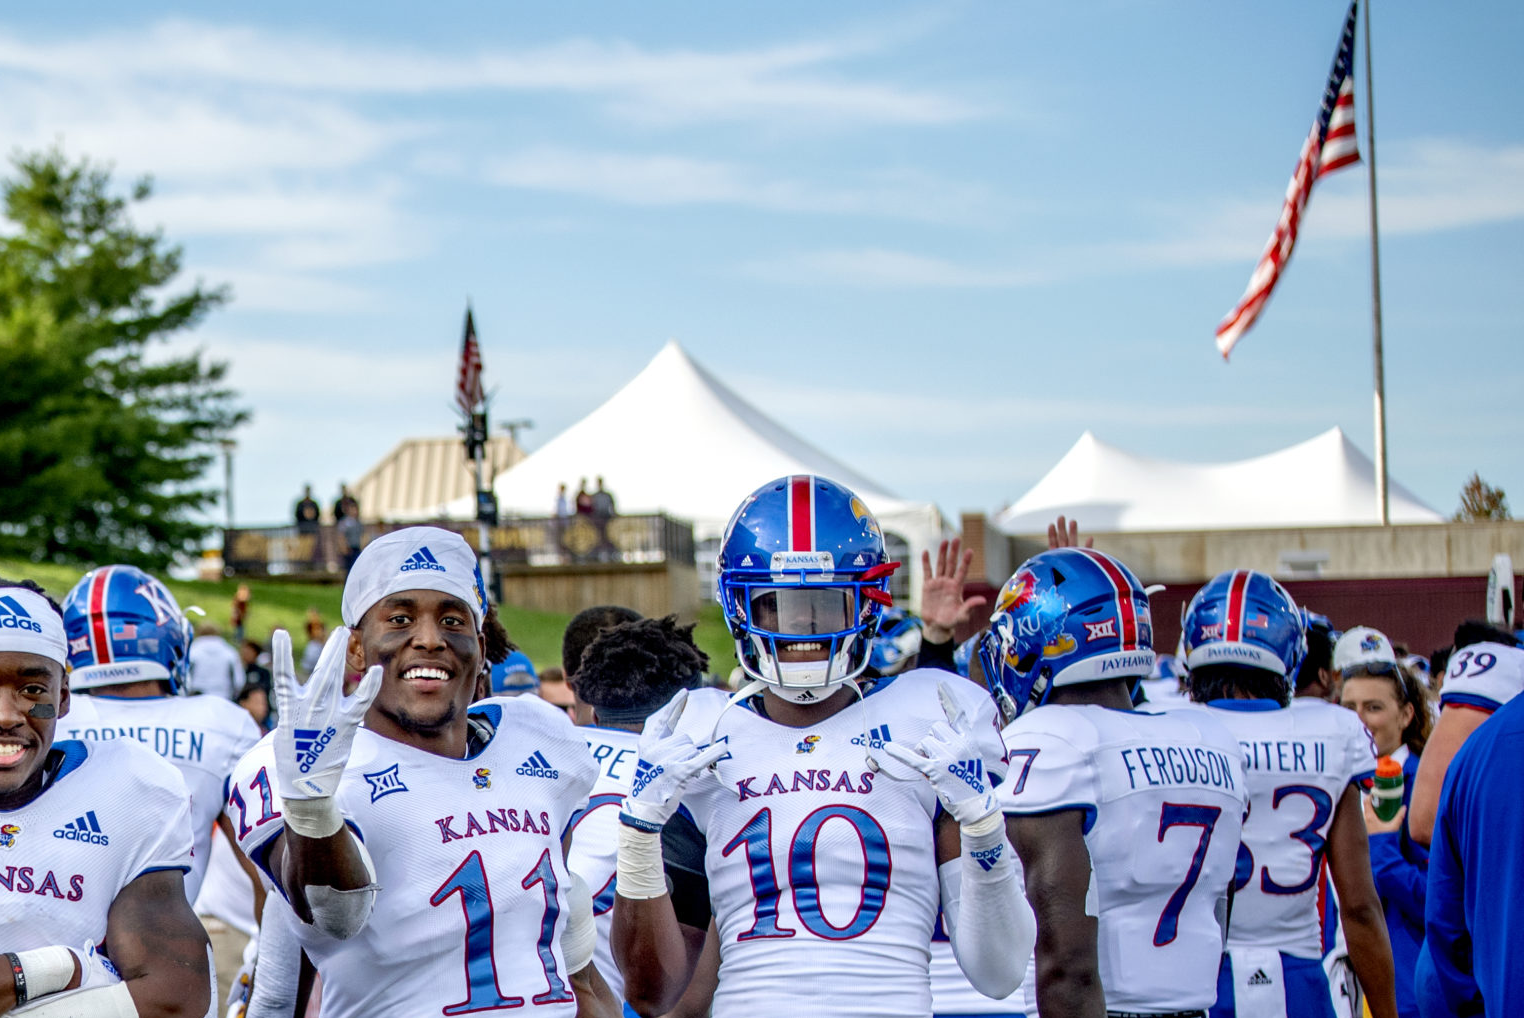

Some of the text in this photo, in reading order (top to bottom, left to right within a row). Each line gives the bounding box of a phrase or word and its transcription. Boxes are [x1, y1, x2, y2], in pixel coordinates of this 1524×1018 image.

[400, 561, 446, 573] adidas
[786, 555, 819, 564] KANSAS
[1016, 612, 1041, 637] KU
[1084, 618, 1118, 641] XII
[83, 666, 141, 682] JAYHAWKS
[1450, 651, 1498, 680] 39
[68, 728, 204, 763] EDEN
[299, 726, 336, 773] adidas
[587, 741, 636, 779] RE
[1315, 741, 1325, 772] II
[366, 766, 407, 800] XII
[515, 767, 559, 780] adidas
[632, 765, 664, 797] adidas
[736, 768, 874, 802] KANSAS
[947, 764, 984, 795] adidas
[1007, 748, 1041, 796] 7
[1122, 746, 1235, 792] FERGUSON
[226, 766, 285, 842] 11
[53, 828, 109, 847] adidas
[436, 808, 551, 844] KANSAS
[1233, 785, 1333, 896] 3
[970, 843, 1004, 859] adidas
[722, 803, 892, 942] 10
[1153, 802, 1222, 947] 7
[429, 848, 574, 1017] 11
